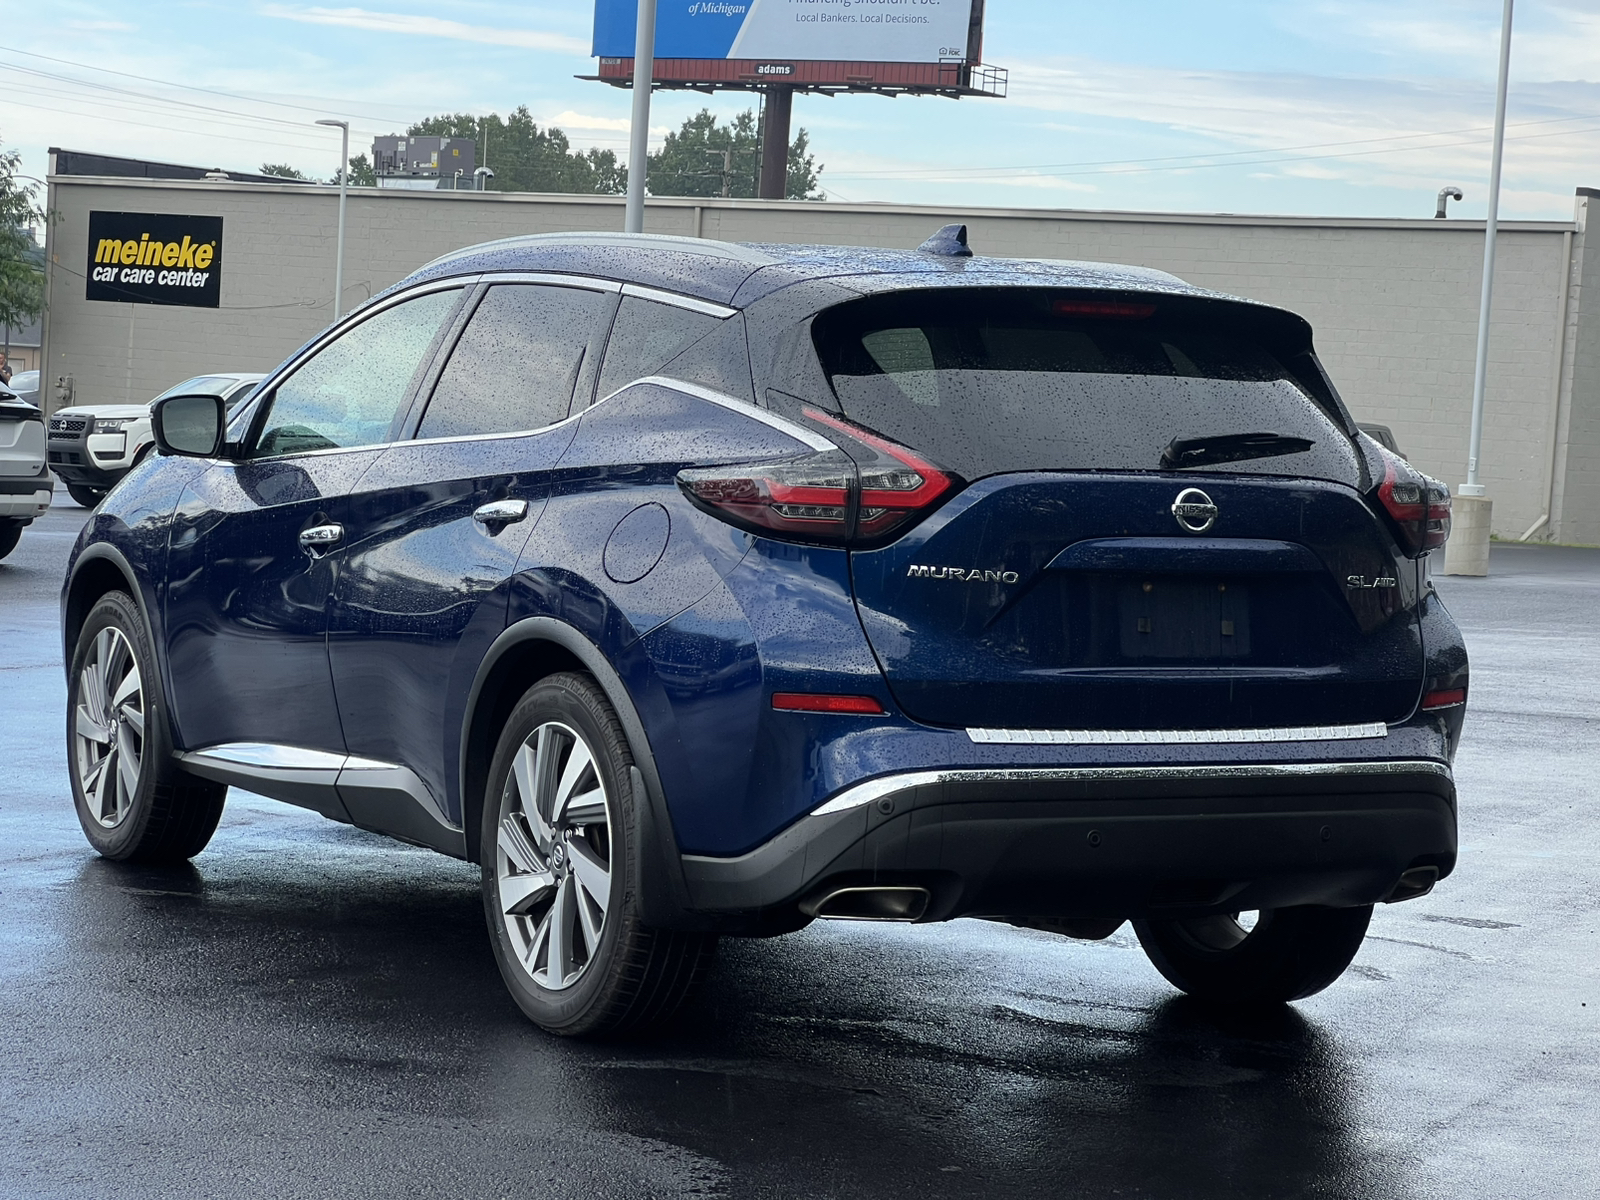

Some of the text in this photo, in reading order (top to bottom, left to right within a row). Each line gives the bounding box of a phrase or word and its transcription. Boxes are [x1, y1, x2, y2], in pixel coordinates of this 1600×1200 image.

[688, 2, 746, 17] of Michigan
[795, 13, 930, 24] Local Bankers. Local Decisions.
[758, 64, 791, 74] adams
[92, 266, 210, 287] car care center
[906, 564, 1019, 584] MURANO
